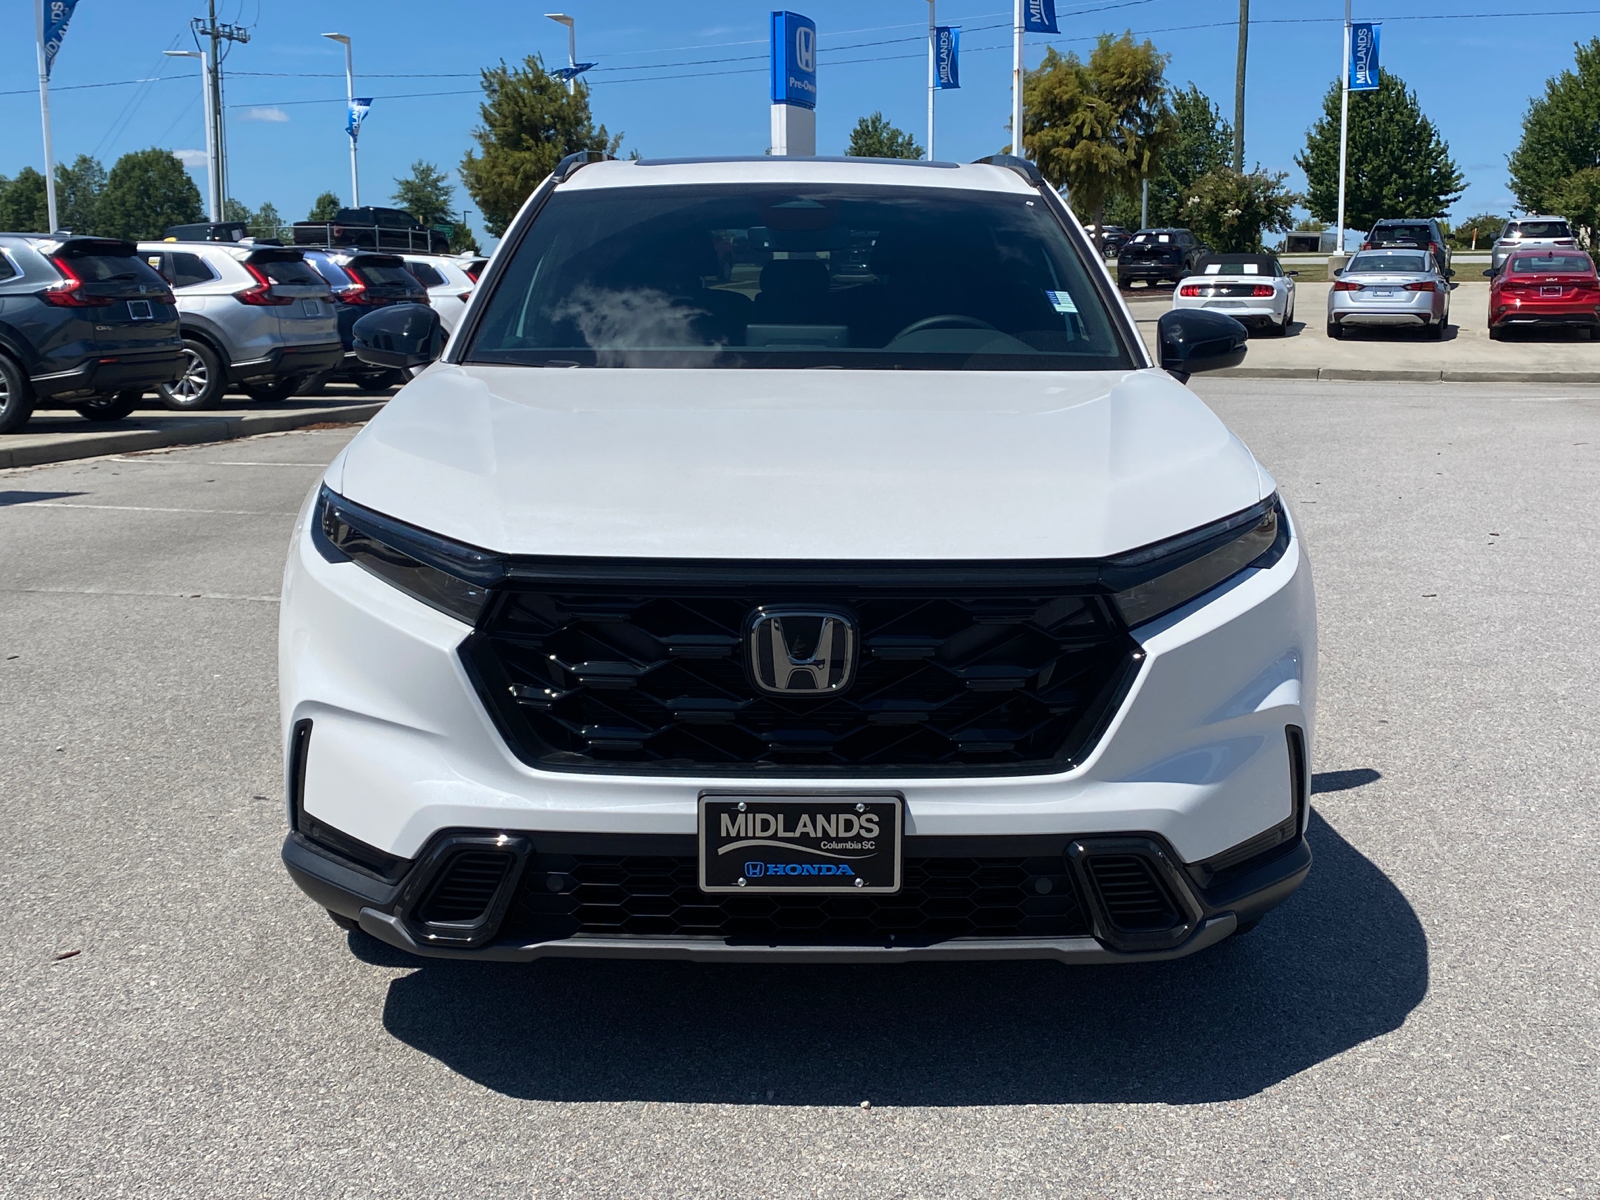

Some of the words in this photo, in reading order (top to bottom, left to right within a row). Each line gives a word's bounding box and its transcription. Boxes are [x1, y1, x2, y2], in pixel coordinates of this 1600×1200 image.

[940, 31, 949, 83] MIDLANDS
[1356, 28, 1368, 84] MIDLANDS
[720, 813, 880, 838] MIDLANDS
[820, 841, 861, 850] Columbia
[862, 841, 876, 850] SC
[766, 864, 855, 876] HONDA
